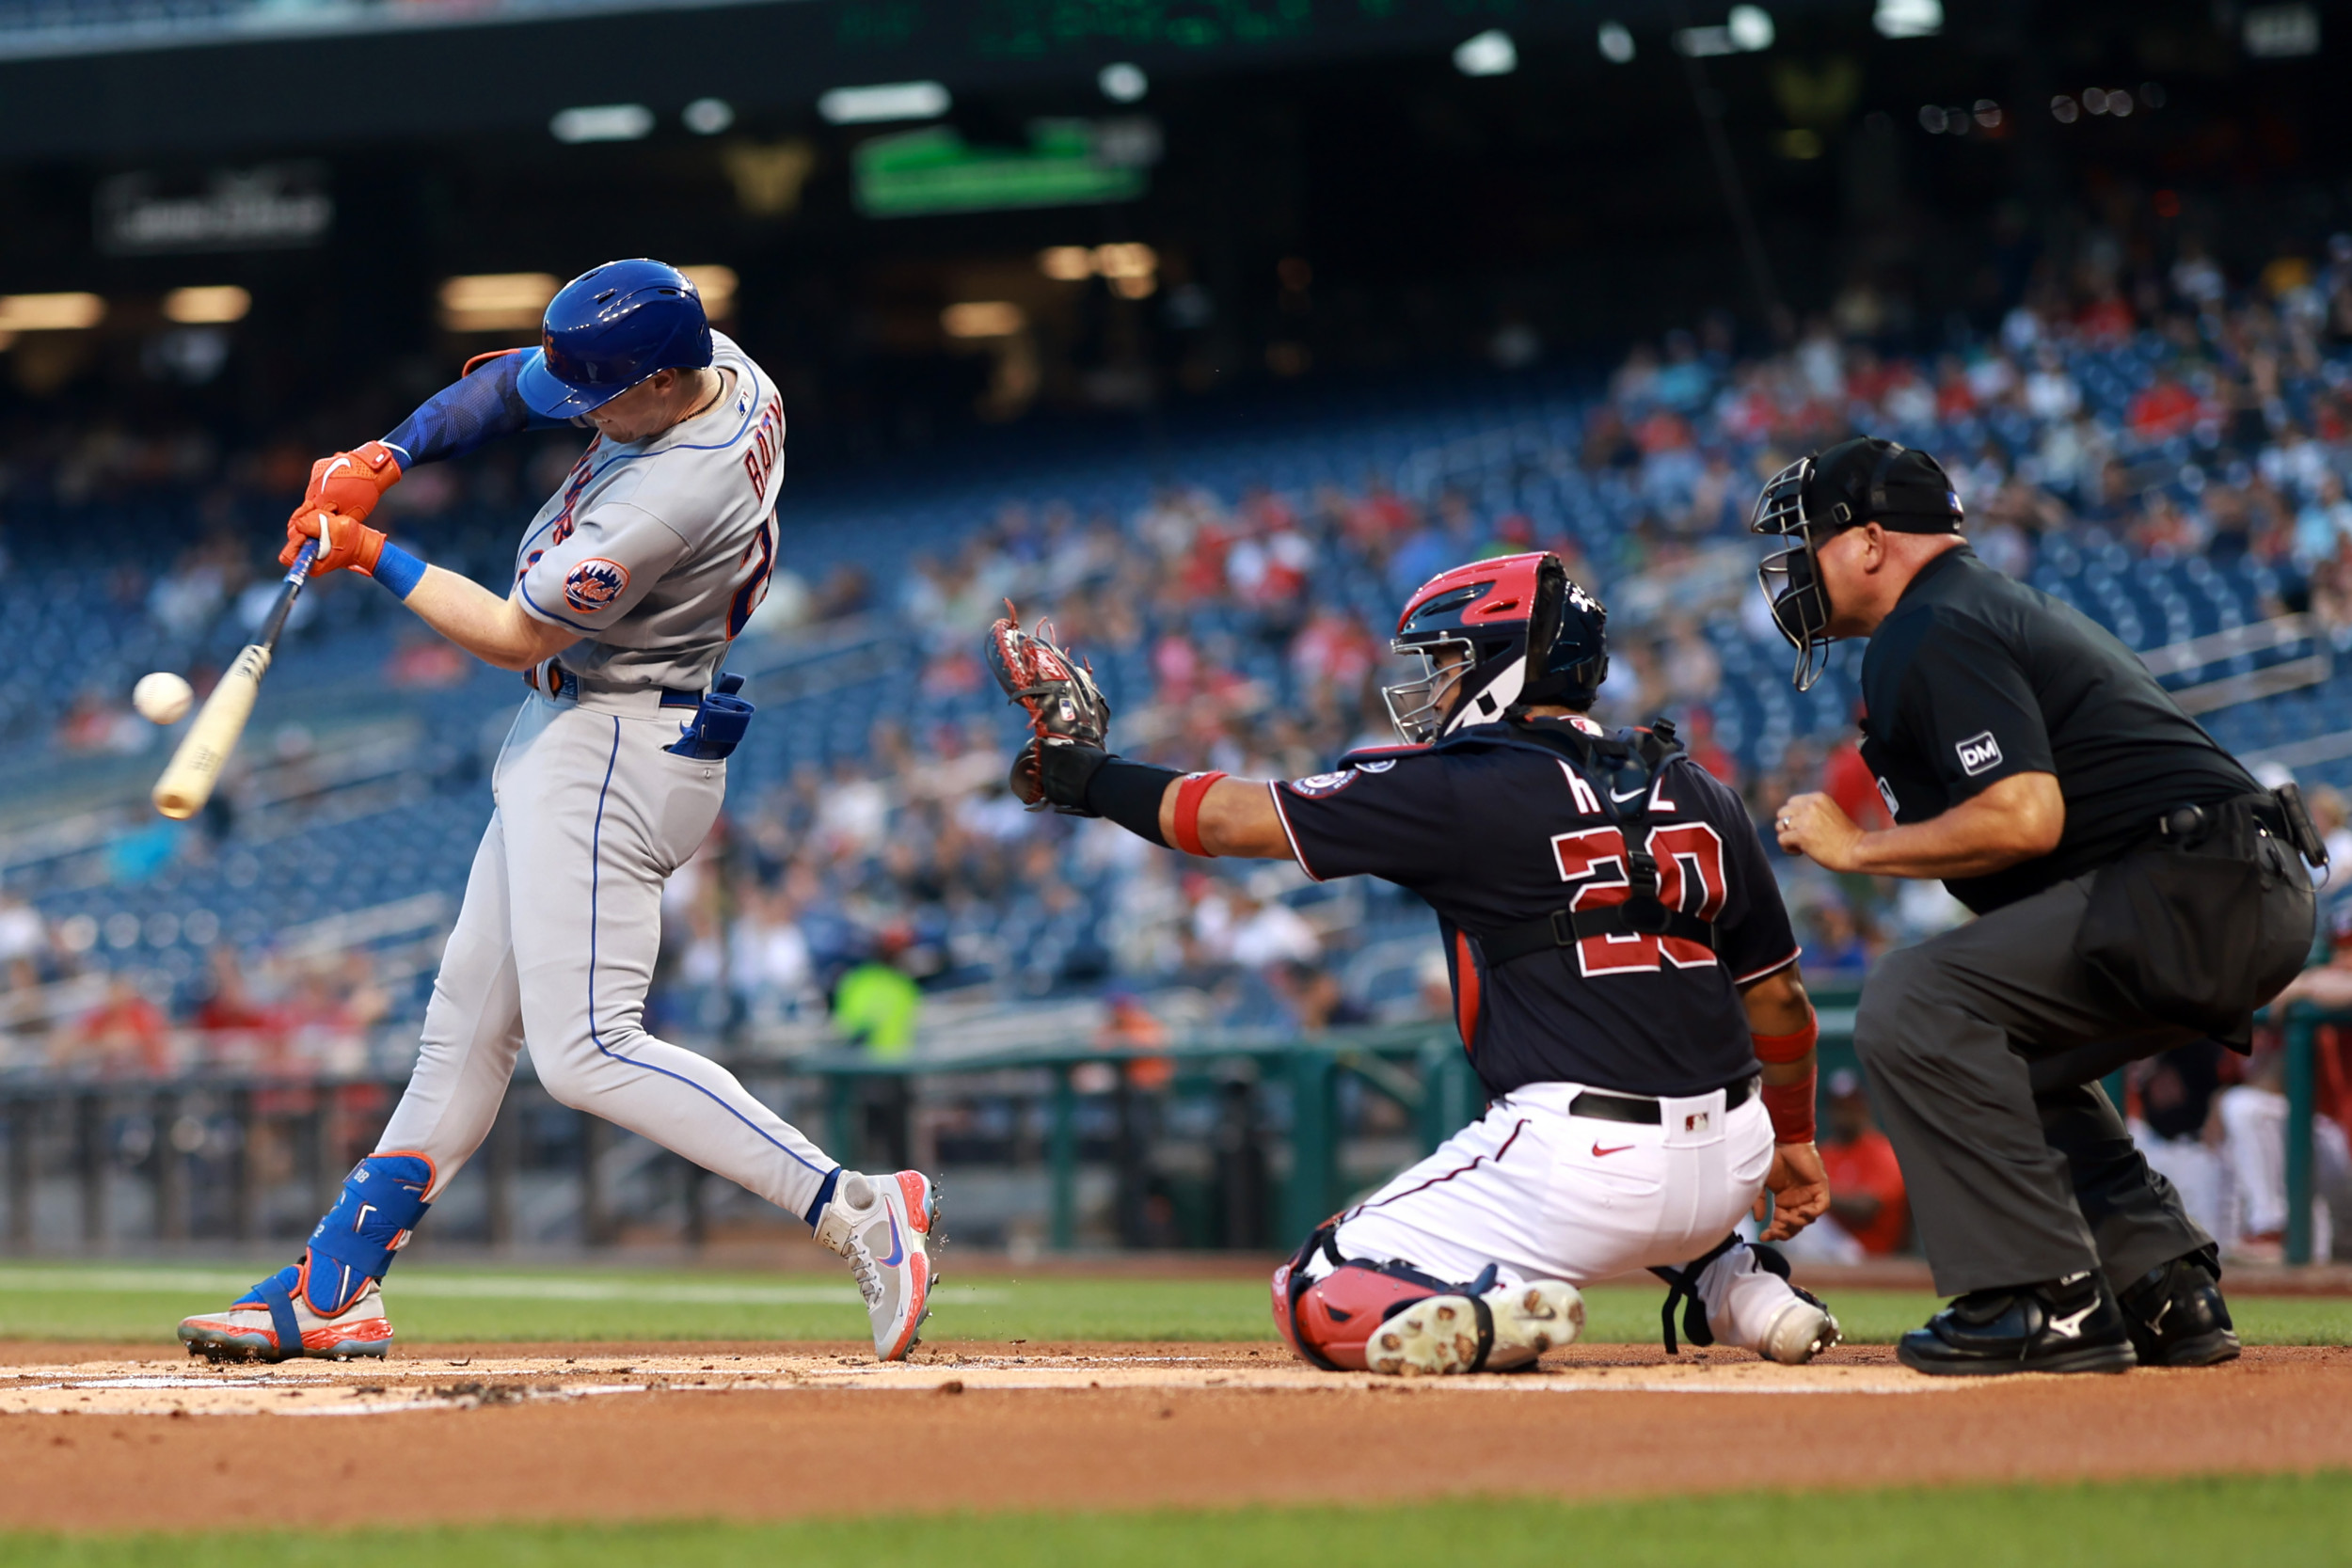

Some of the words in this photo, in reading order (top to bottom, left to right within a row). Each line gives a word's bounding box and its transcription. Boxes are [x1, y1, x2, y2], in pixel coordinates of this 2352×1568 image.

[571, 578, 615, 601] Mets
[1962, 739, 1996, 767] DM
[1549, 821, 1727, 978] 20
[354, 1169, 370, 1182] BB
